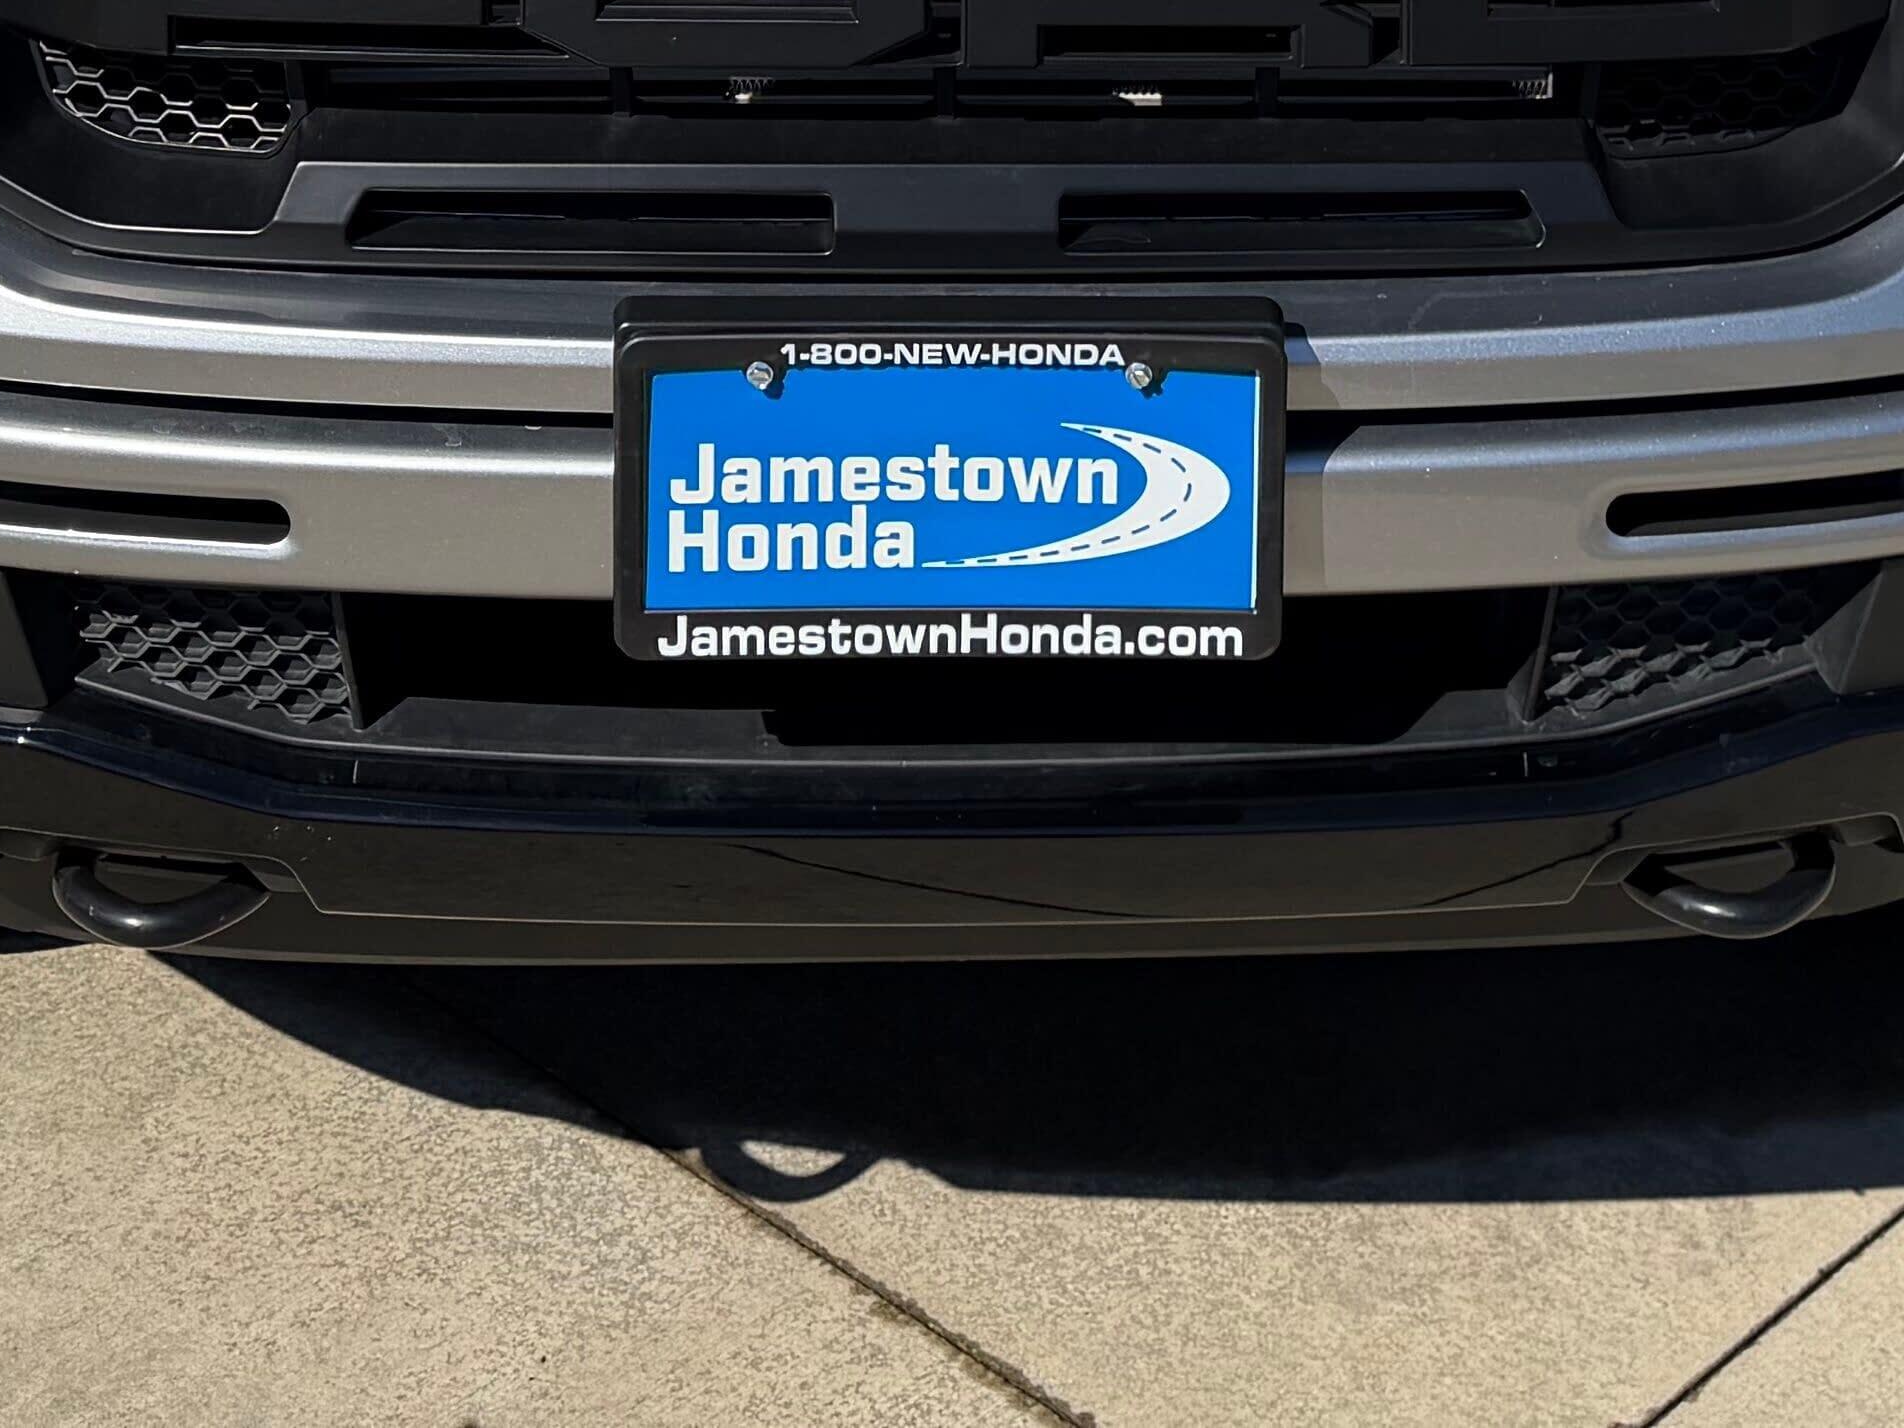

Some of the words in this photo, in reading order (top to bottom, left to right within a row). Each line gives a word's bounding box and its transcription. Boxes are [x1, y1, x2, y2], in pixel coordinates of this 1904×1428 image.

[779, 342, 1126, 369] 1-800-NEW-HONDA
[670, 442, 1119, 506] Jamestown
[667, 504, 916, 574] Honda
[656, 613, 1244, 659] JamestownHonda.com
